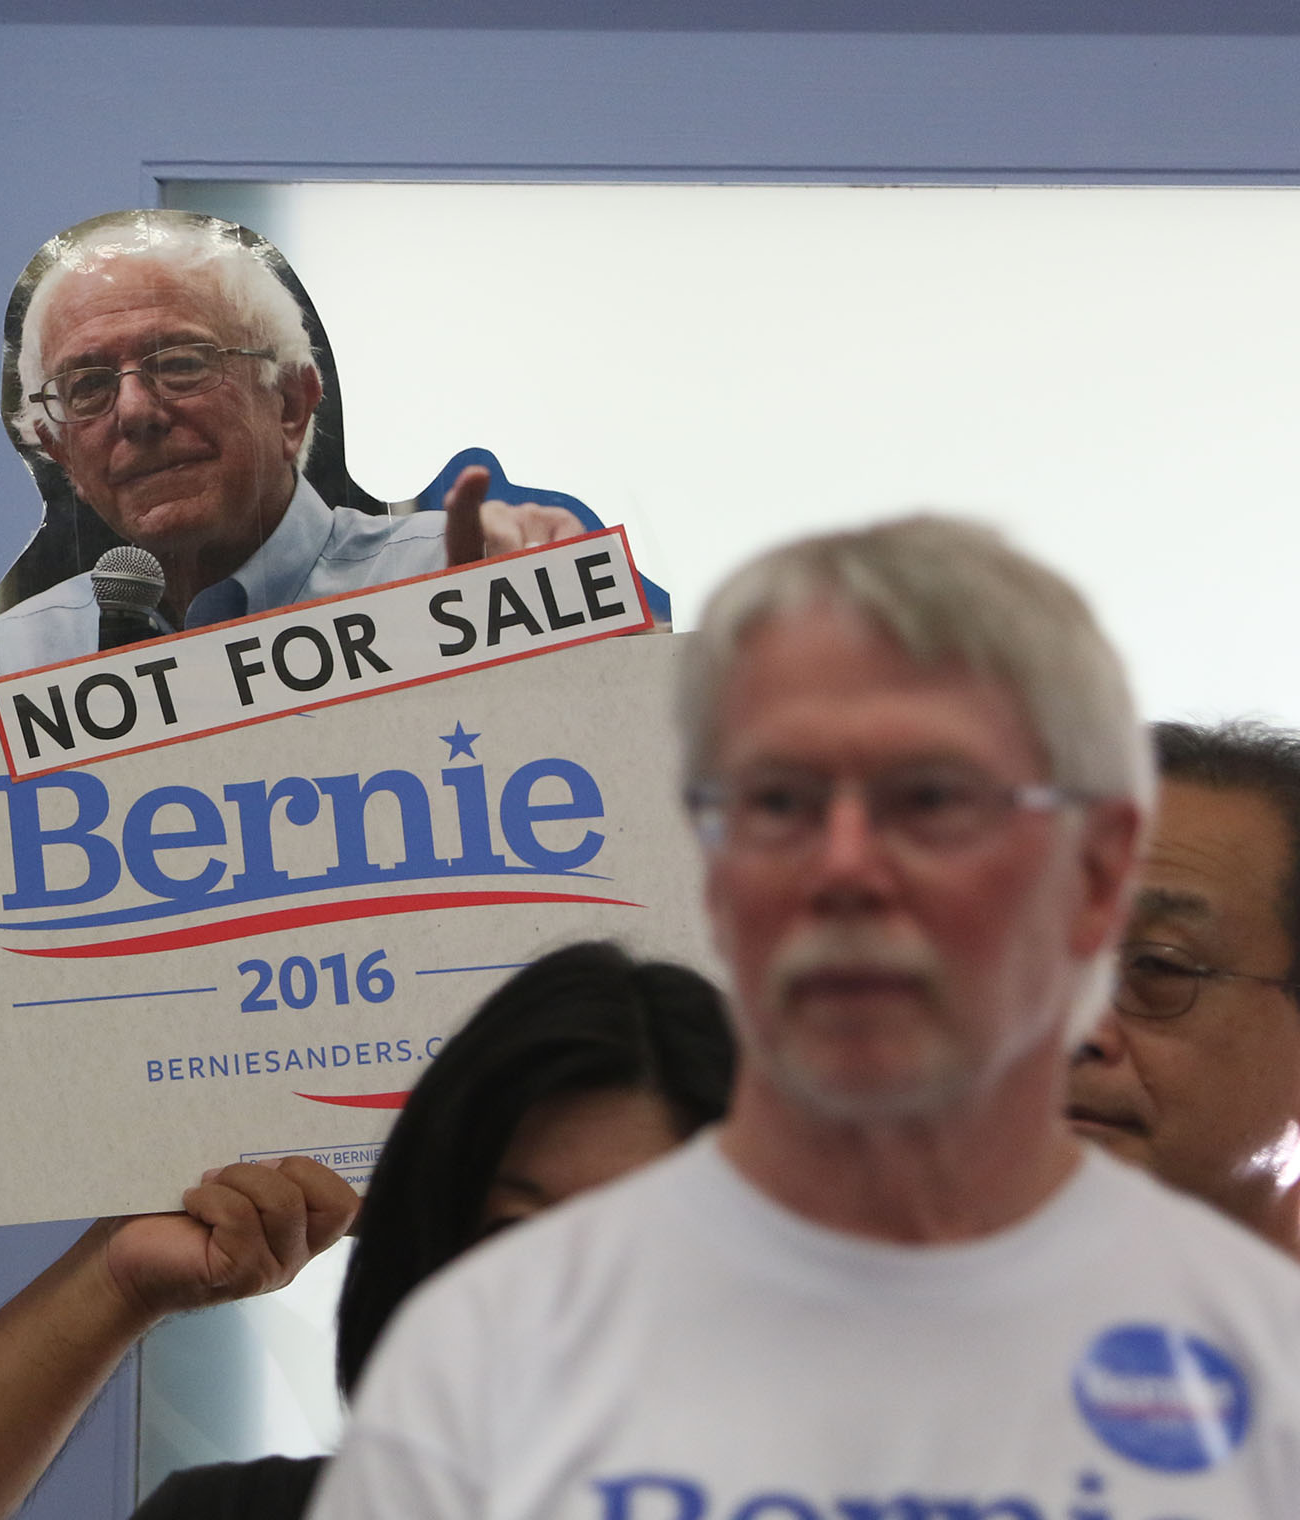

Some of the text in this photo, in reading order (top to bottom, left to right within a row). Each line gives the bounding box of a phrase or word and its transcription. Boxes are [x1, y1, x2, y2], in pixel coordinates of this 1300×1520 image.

[11, 551, 627, 759] NOT FOR SALE
[236, 948, 396, 1013] 2016
